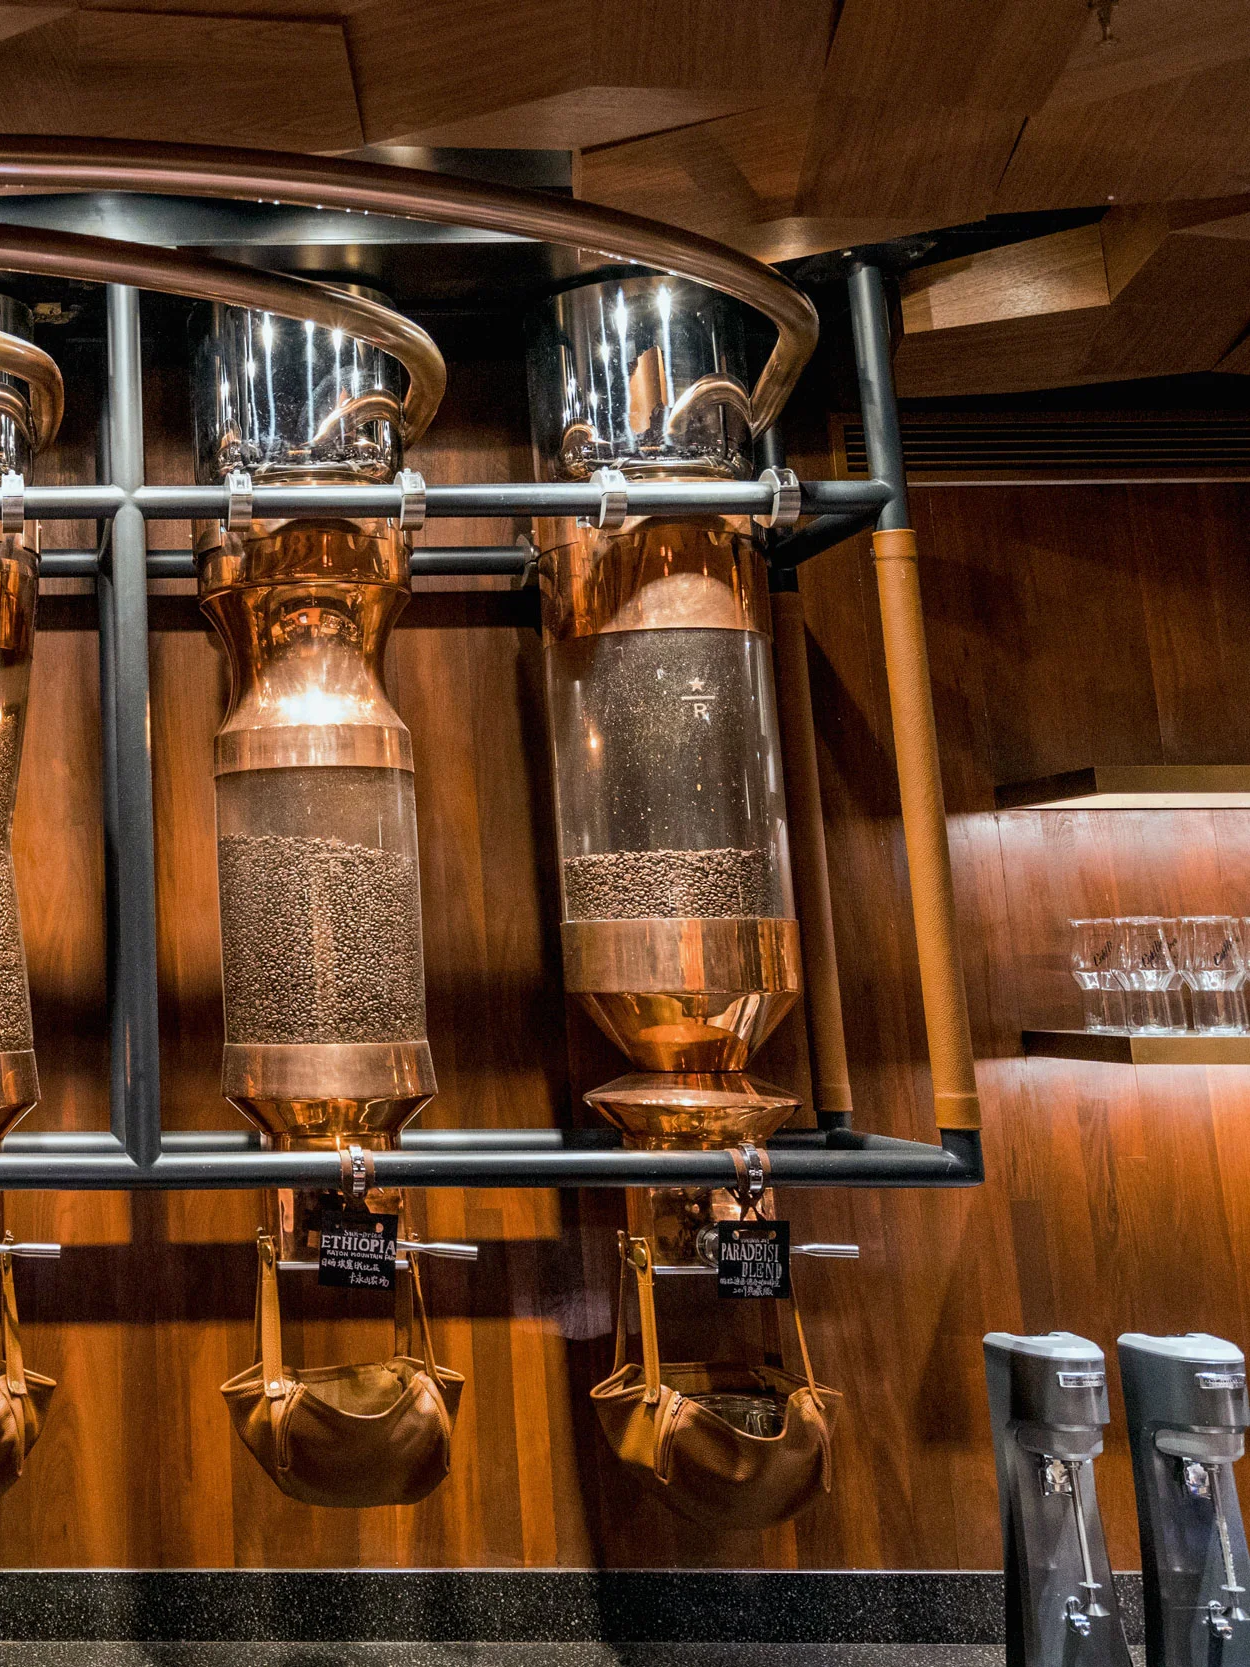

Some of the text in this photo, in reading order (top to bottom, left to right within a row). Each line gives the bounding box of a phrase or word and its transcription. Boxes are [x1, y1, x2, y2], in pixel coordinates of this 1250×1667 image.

[321, 1234, 397, 1256] ETHIOPIA
[721, 1242, 780, 1262] PARADEISI
[741, 1261, 783, 1280] BLEND
